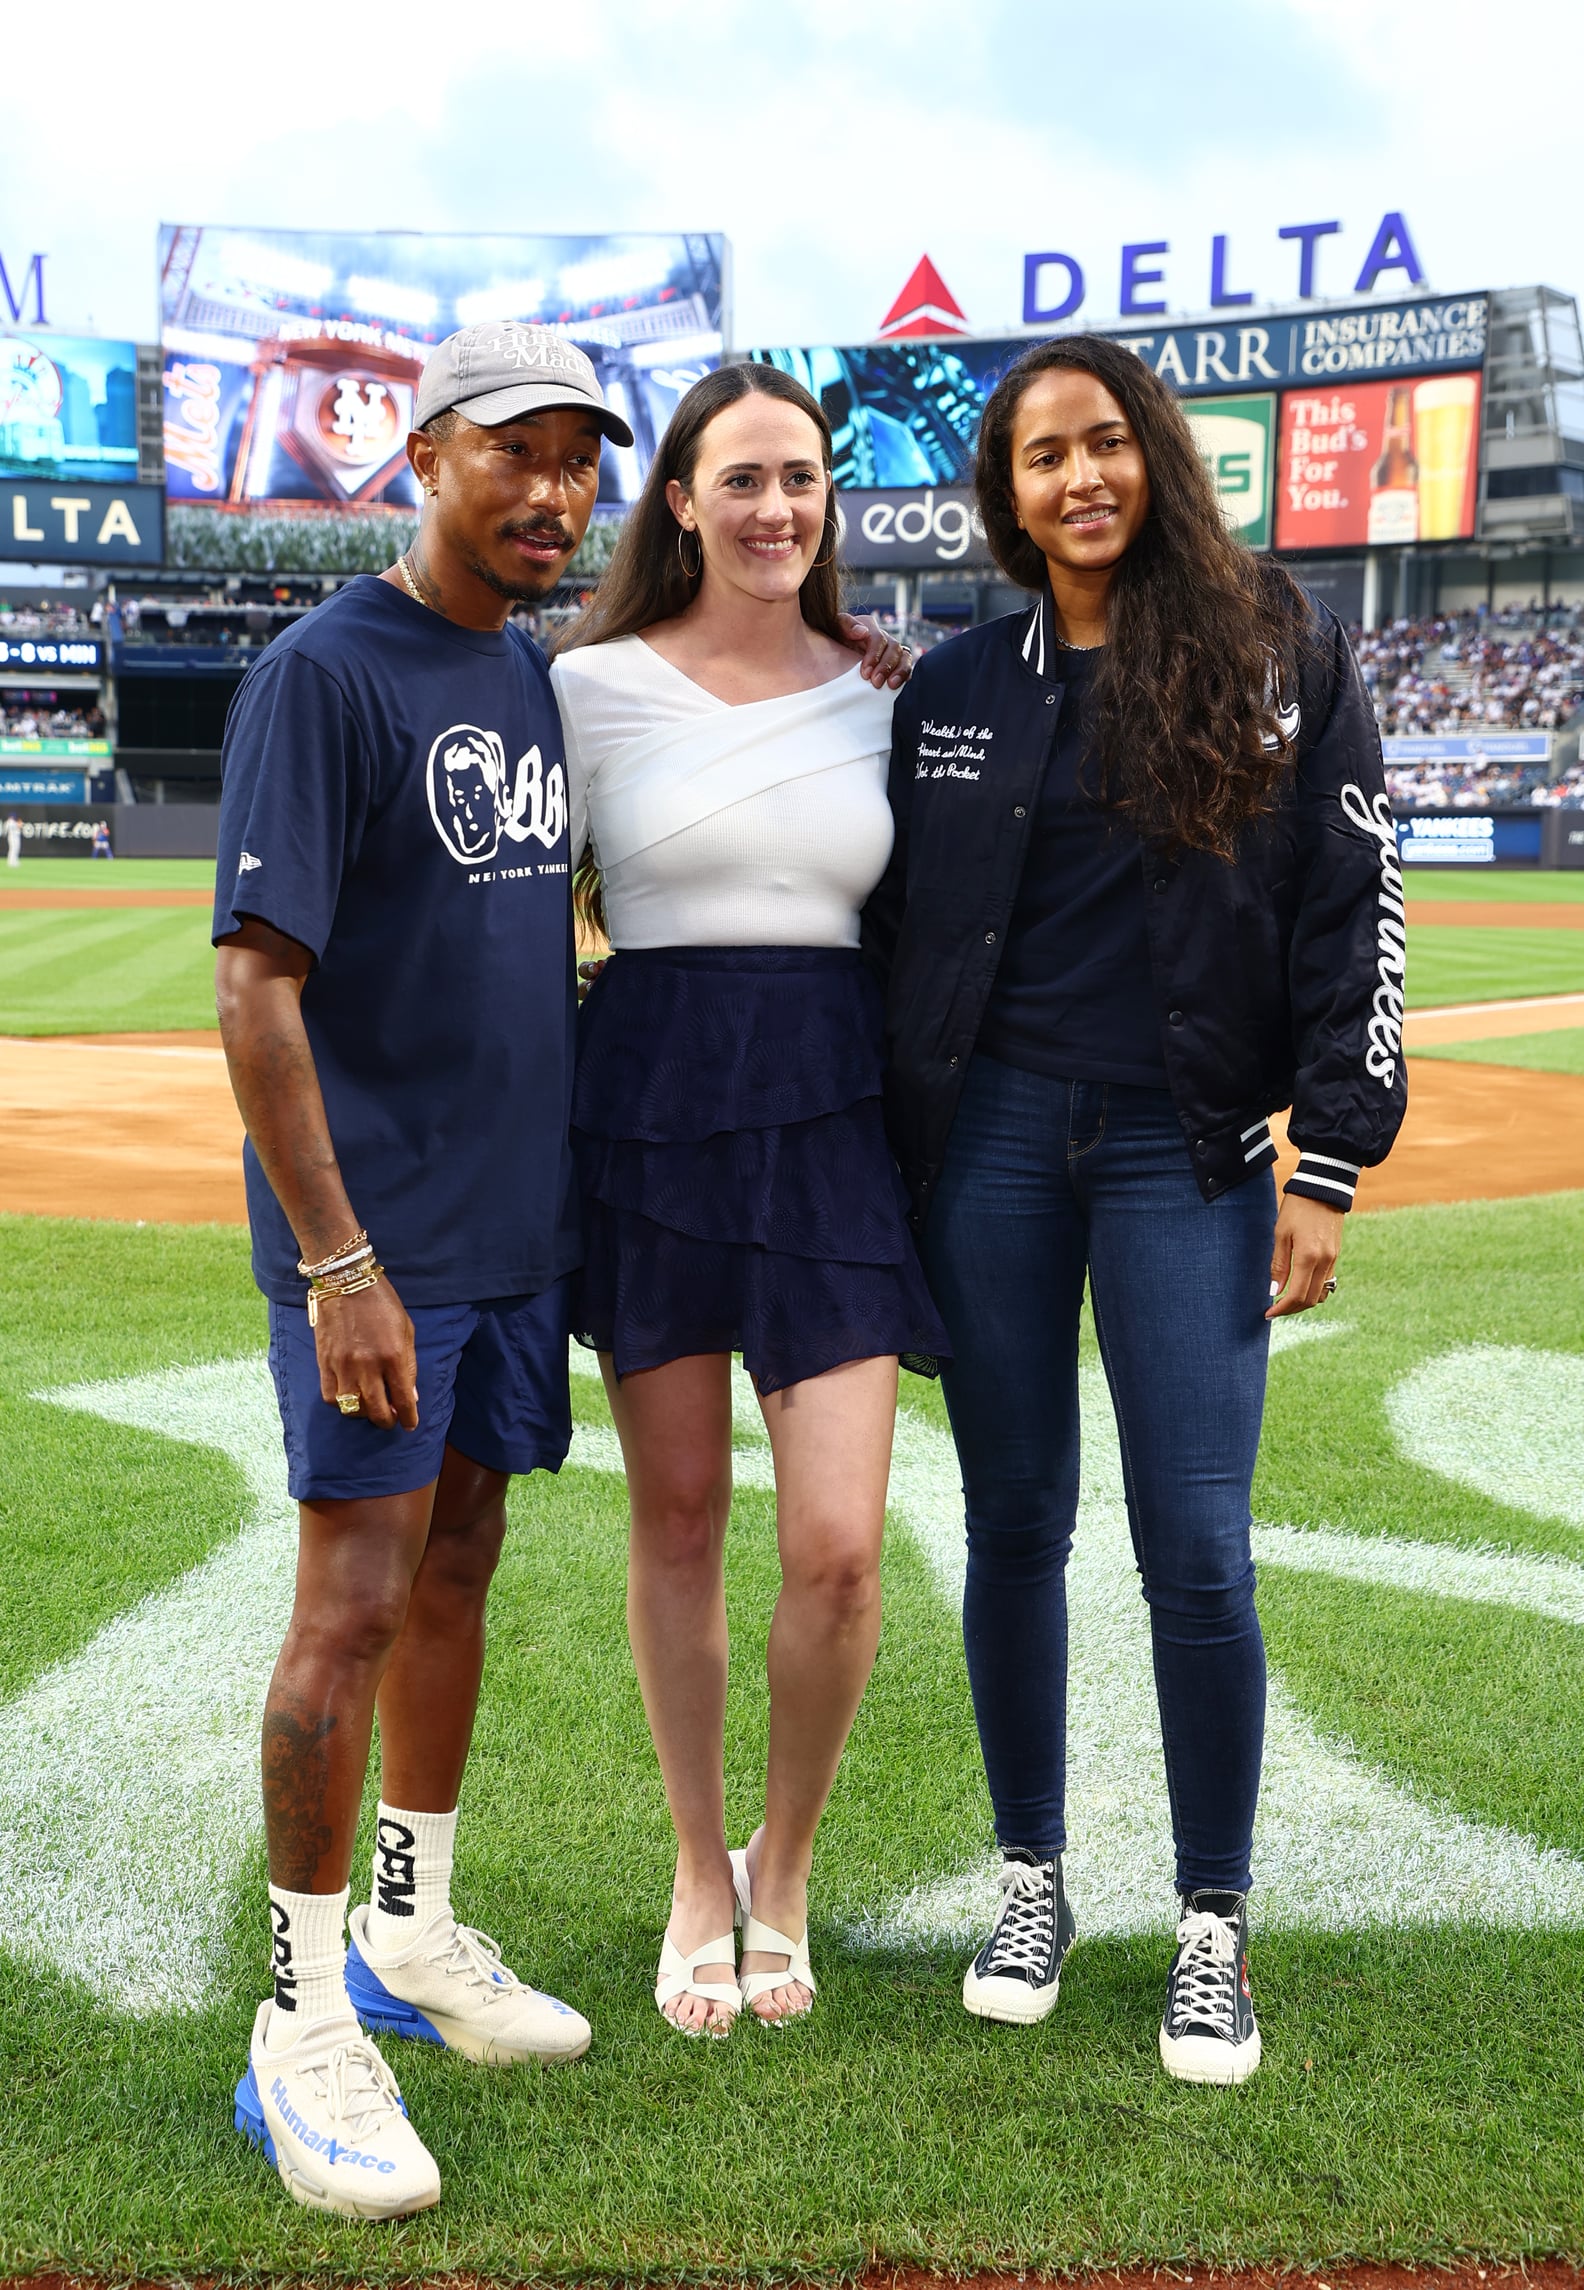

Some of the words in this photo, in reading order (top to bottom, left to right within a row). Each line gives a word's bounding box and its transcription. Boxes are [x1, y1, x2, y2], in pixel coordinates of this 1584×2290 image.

[1023, 212, 1428, 324] DELTA
[324, 319, 382, 347] YORK
[1304, 300, 1488, 349] INSURANCE
[1301, 329, 1487, 376] COMPANIES
[1290, 396, 1356, 427] This
[162, 362, 222, 493] Mets
[1291, 424, 1368, 456] Bud's
[1289, 456, 1338, 484] For
[1288, 484, 1349, 512] You.
[921, 720, 961, 739] Wealth
[962, 726, 977, 739] of
[976, 728, 994, 740] the
[917, 742, 941, 757] Heart
[947, 762, 981, 781] Pocket
[468, 871, 496, 884] NE
[500, 866, 533, 880] YORK
